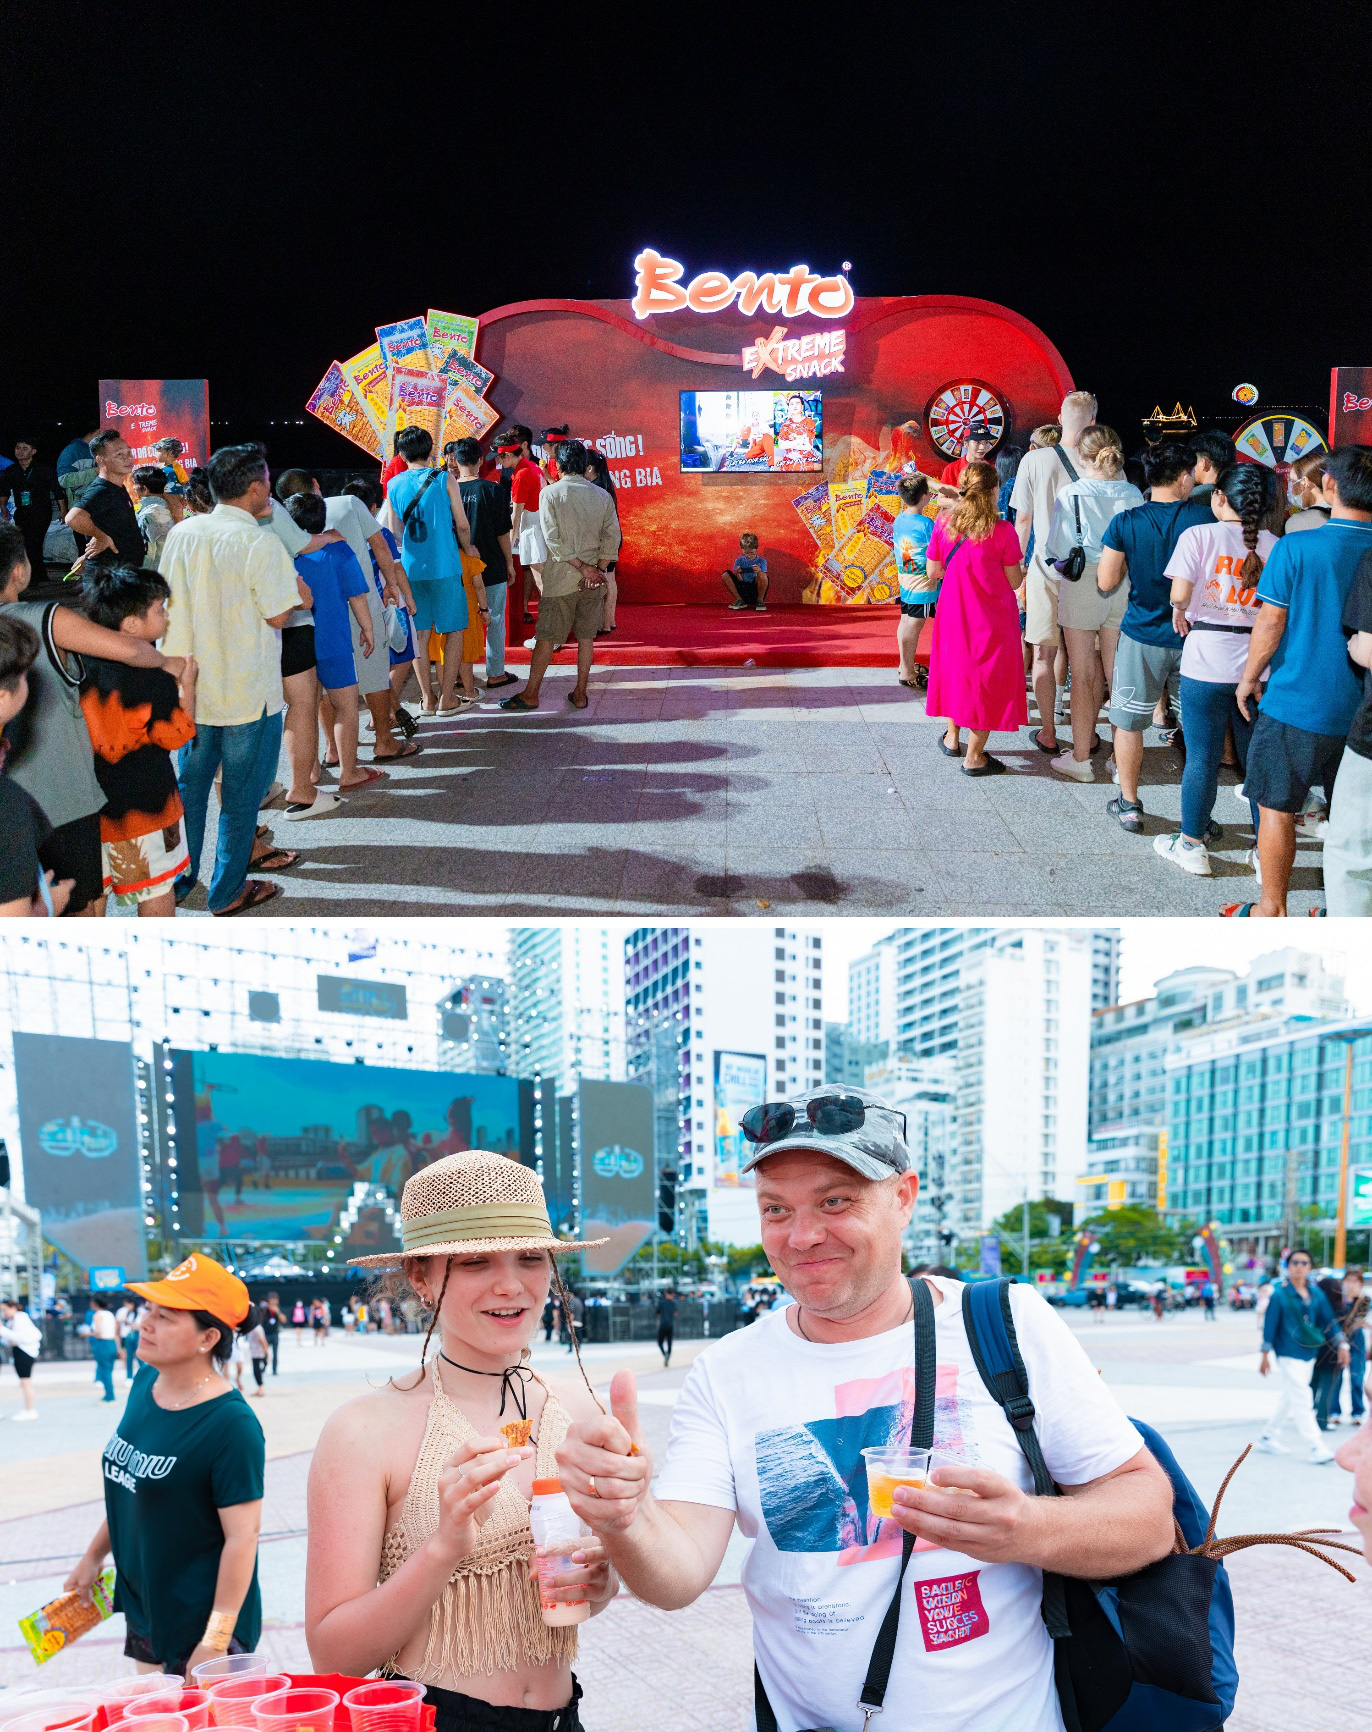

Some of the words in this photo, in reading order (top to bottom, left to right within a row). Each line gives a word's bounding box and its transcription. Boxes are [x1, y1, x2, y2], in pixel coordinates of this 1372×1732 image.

[632, 248, 854, 319] Bento
[387, 338, 422, 352] Bento
[432, 327, 468, 344] Bento
[742, 326, 845, 379] EXTREME
[448, 359, 482, 387] Bento
[785, 355, 845, 382] SNACK
[399, 385, 439, 402] Bento
[1343, 392, 1372, 412] Be
[106, 401, 156, 418] Bento
[453, 397, 483, 430] Bento
[185, 458, 198, 469] BIA
[635, 466, 663, 487] BIA
[835, 493, 863, 502] Bento
